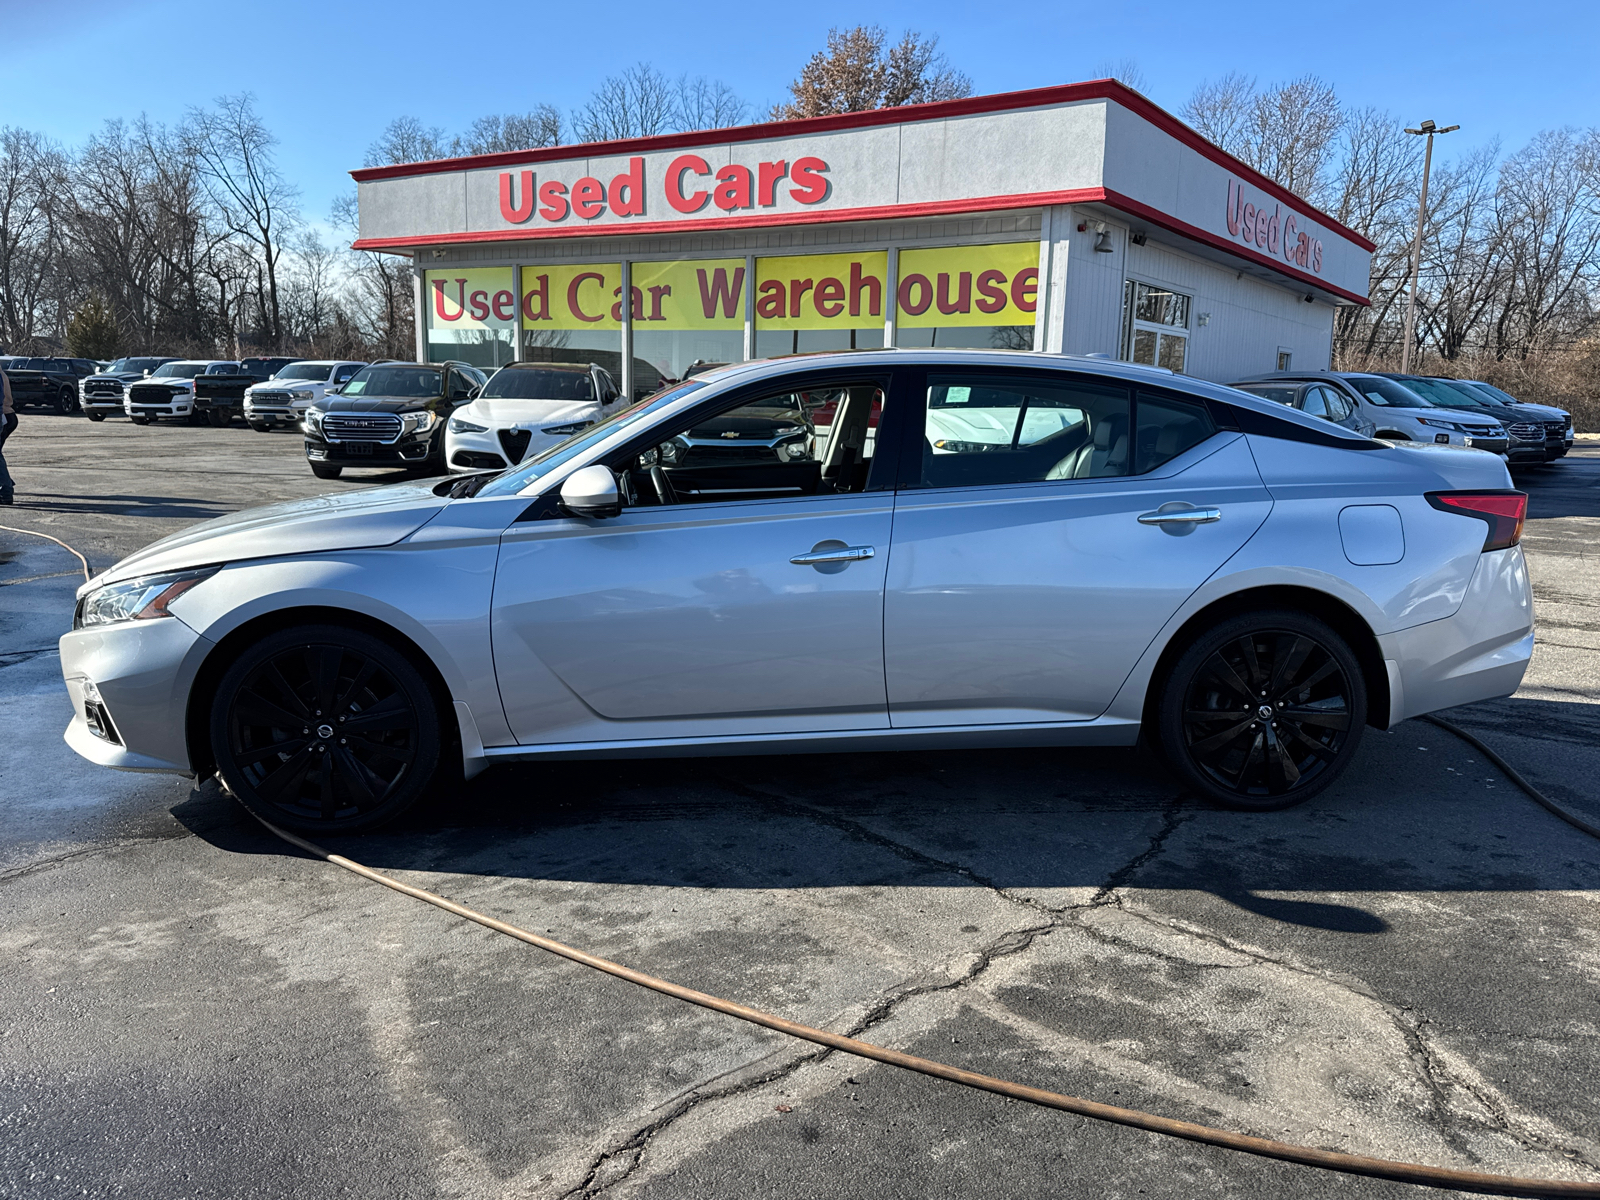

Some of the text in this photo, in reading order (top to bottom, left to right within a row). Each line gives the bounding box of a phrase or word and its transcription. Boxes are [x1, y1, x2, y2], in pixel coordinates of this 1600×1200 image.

[499, 154, 831, 225] Used Cars
[1226, 178, 1323, 273] Used Cars
[431, 262, 1040, 323] Used Car Warehouse
[344, 420, 375, 428] GMC
